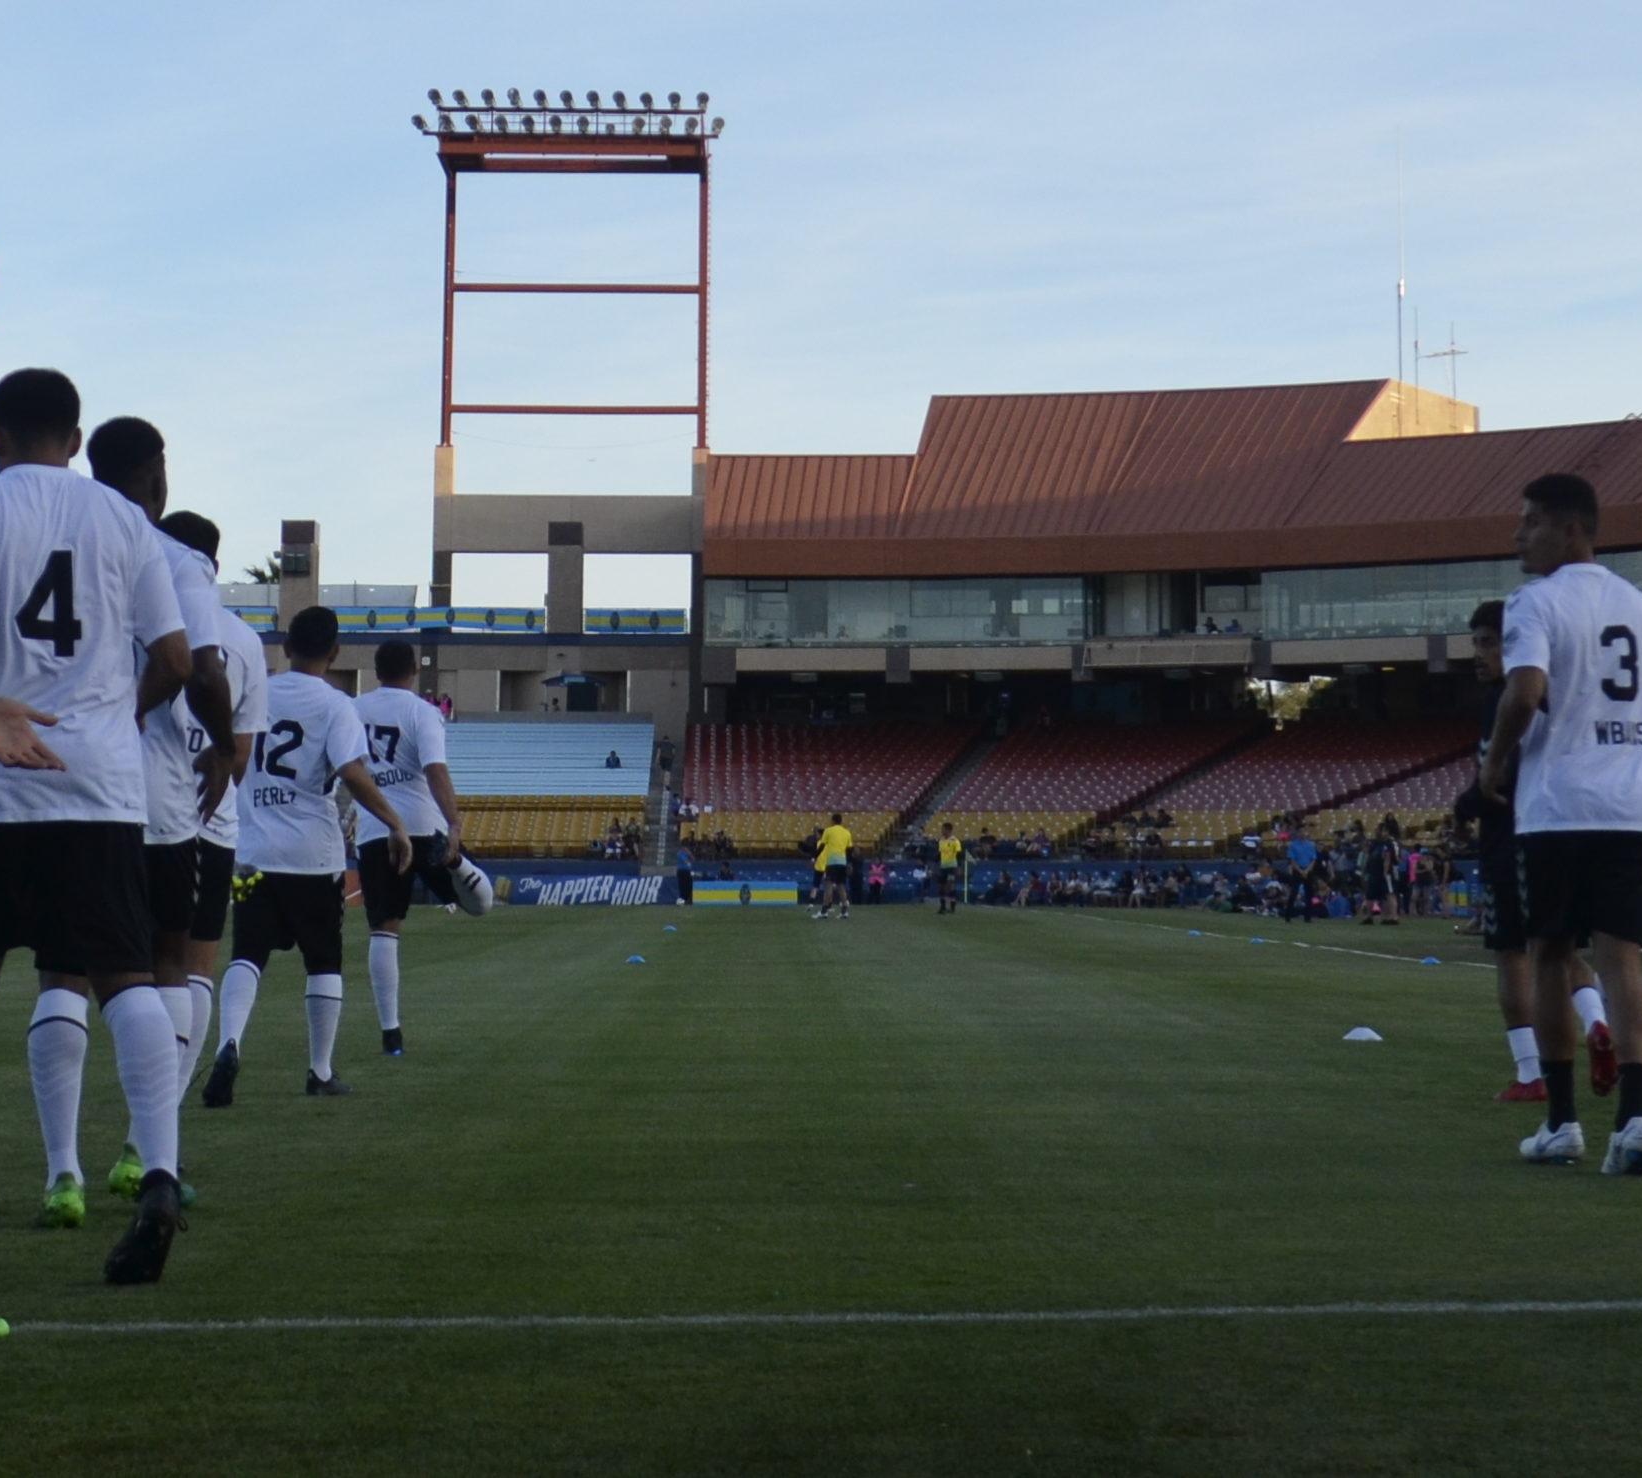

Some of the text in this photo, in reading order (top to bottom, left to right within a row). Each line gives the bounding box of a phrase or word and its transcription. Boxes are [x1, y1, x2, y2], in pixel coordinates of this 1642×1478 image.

[14, 550, 83, 658] 4
[1599, 625, 1640, 703] 3
[254, 719, 304, 780] 12
[364, 723, 401, 764] 17
[518, 875, 664, 905] The HAPPIER HOUR
